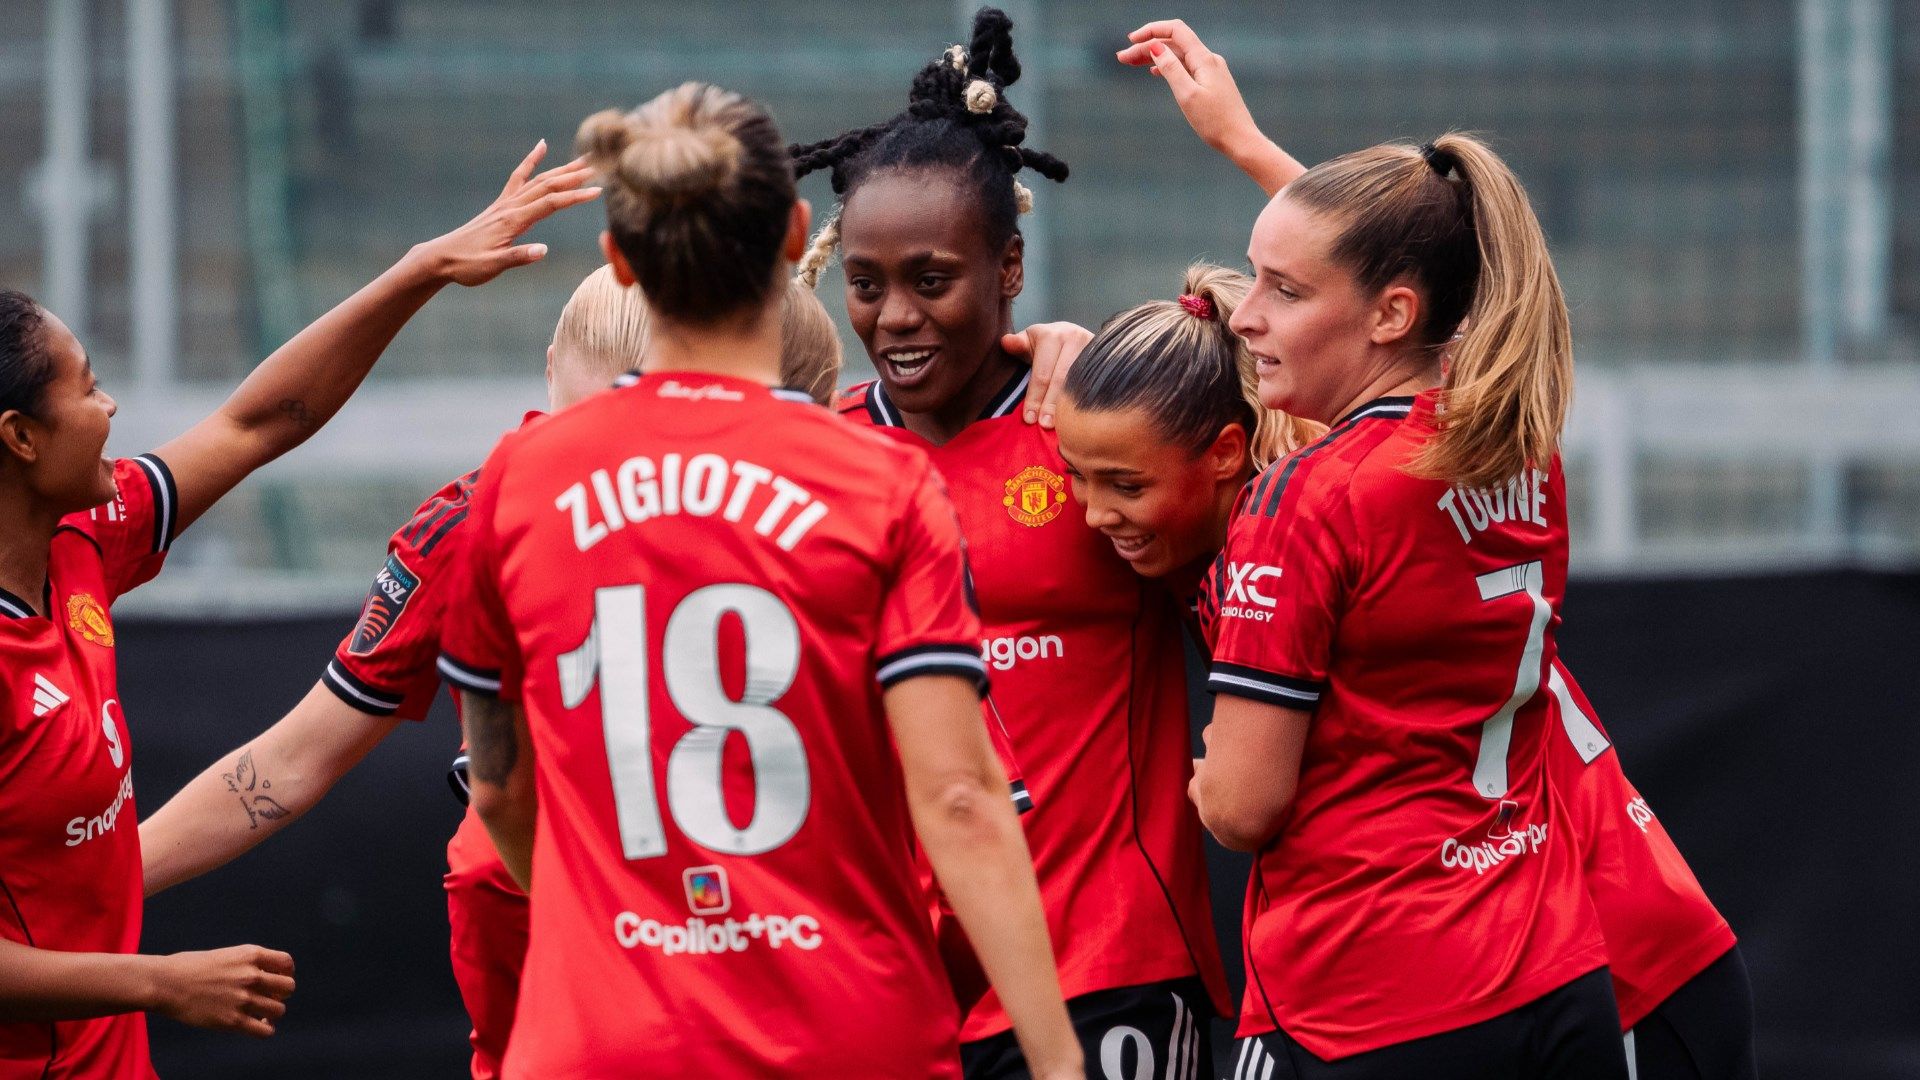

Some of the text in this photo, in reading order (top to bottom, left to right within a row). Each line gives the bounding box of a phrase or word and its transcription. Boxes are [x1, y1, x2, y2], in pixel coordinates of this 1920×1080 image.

[555, 453, 829, 552] ZIGIOTTI
[1010, 470, 1060, 491] MANCHESTER
[1437, 467, 1549, 545] TOONE
[1018, 511, 1053, 523] UNITED
[376, 566, 406, 605] WSL
[1226, 561, 1283, 608] XC
[1472, 560, 1551, 799] 7
[557, 583, 811, 861] 18
